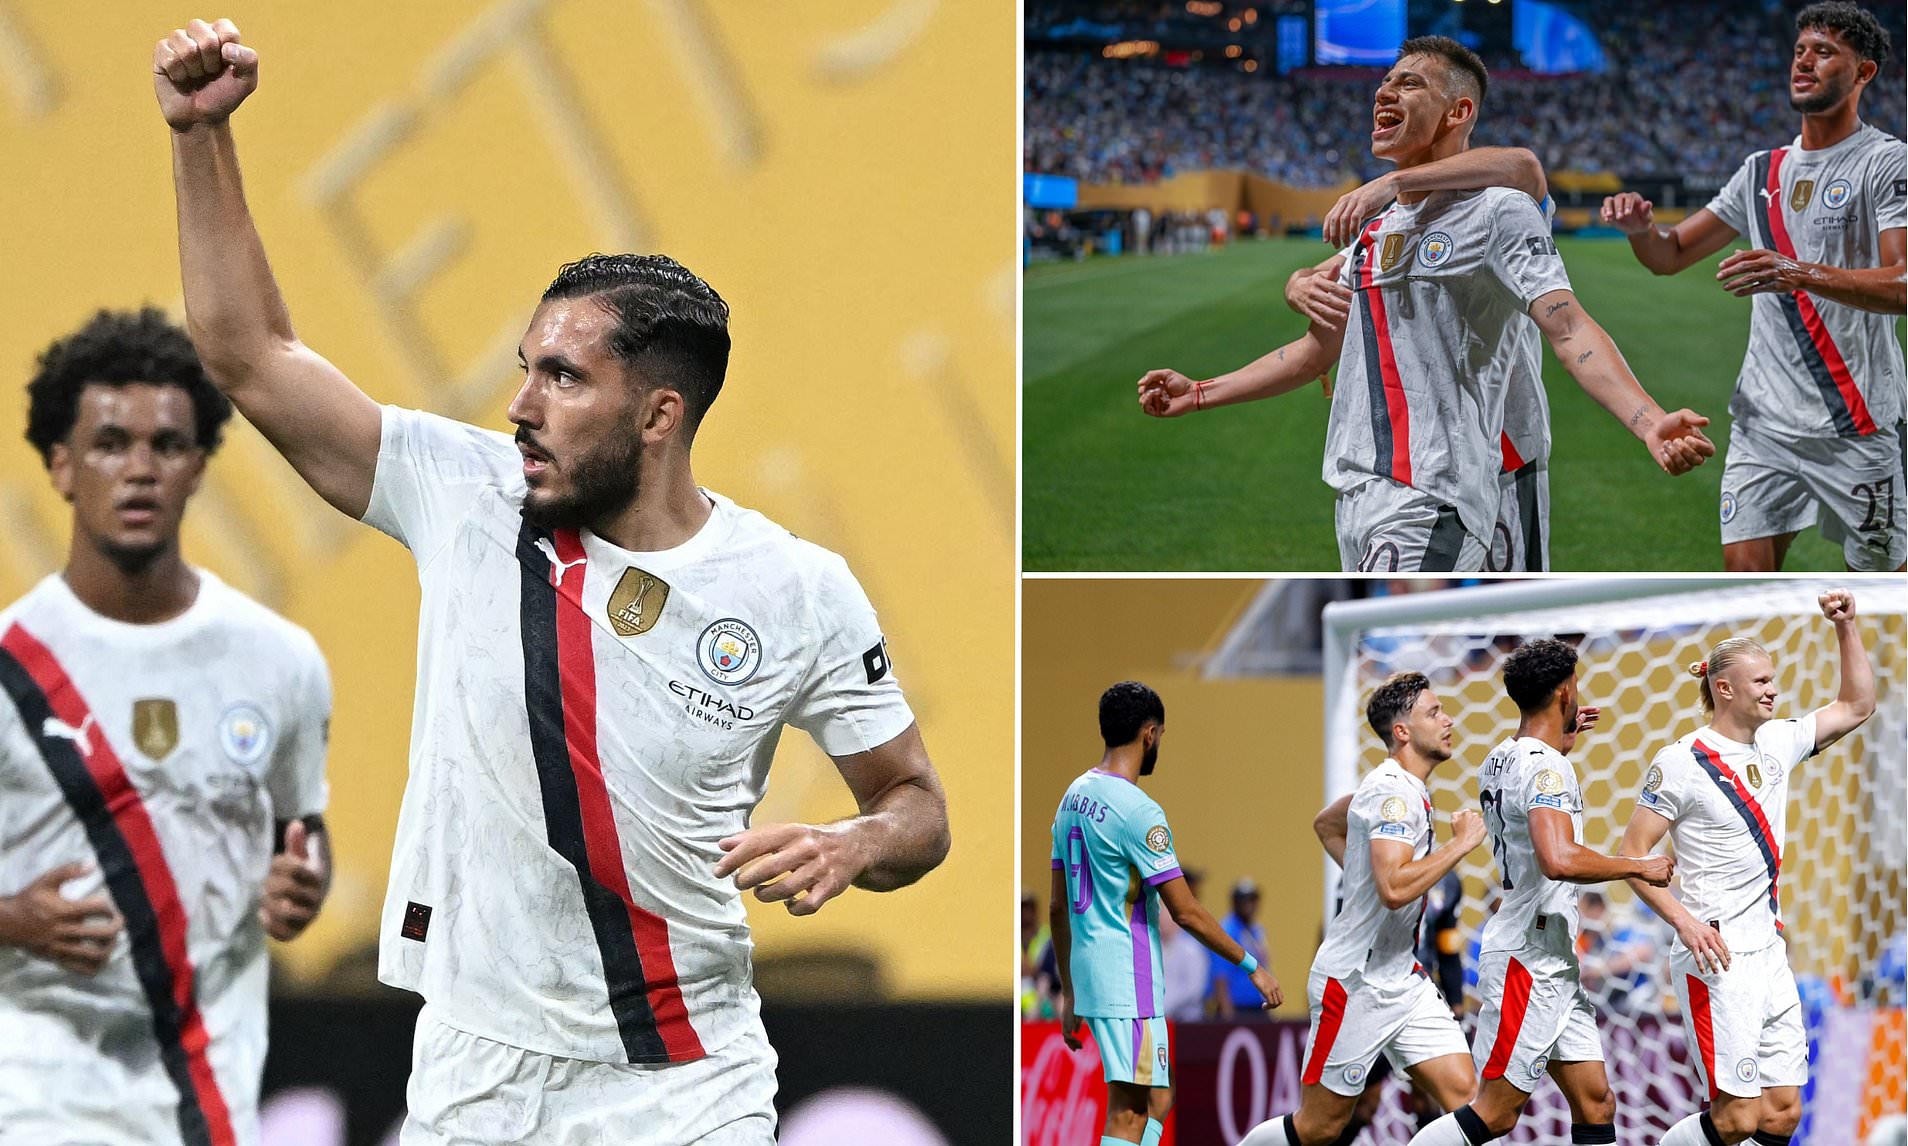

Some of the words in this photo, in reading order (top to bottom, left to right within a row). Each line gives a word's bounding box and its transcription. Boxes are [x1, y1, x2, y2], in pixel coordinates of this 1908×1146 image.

[618, 608, 641, 626] FIFA
[710, 623, 757, 654] MANCHESTER
[710, 668, 729, 680] CITY
[668, 680, 754, 721] ETIHAD
[684, 704, 733, 731] AIRWAYS
